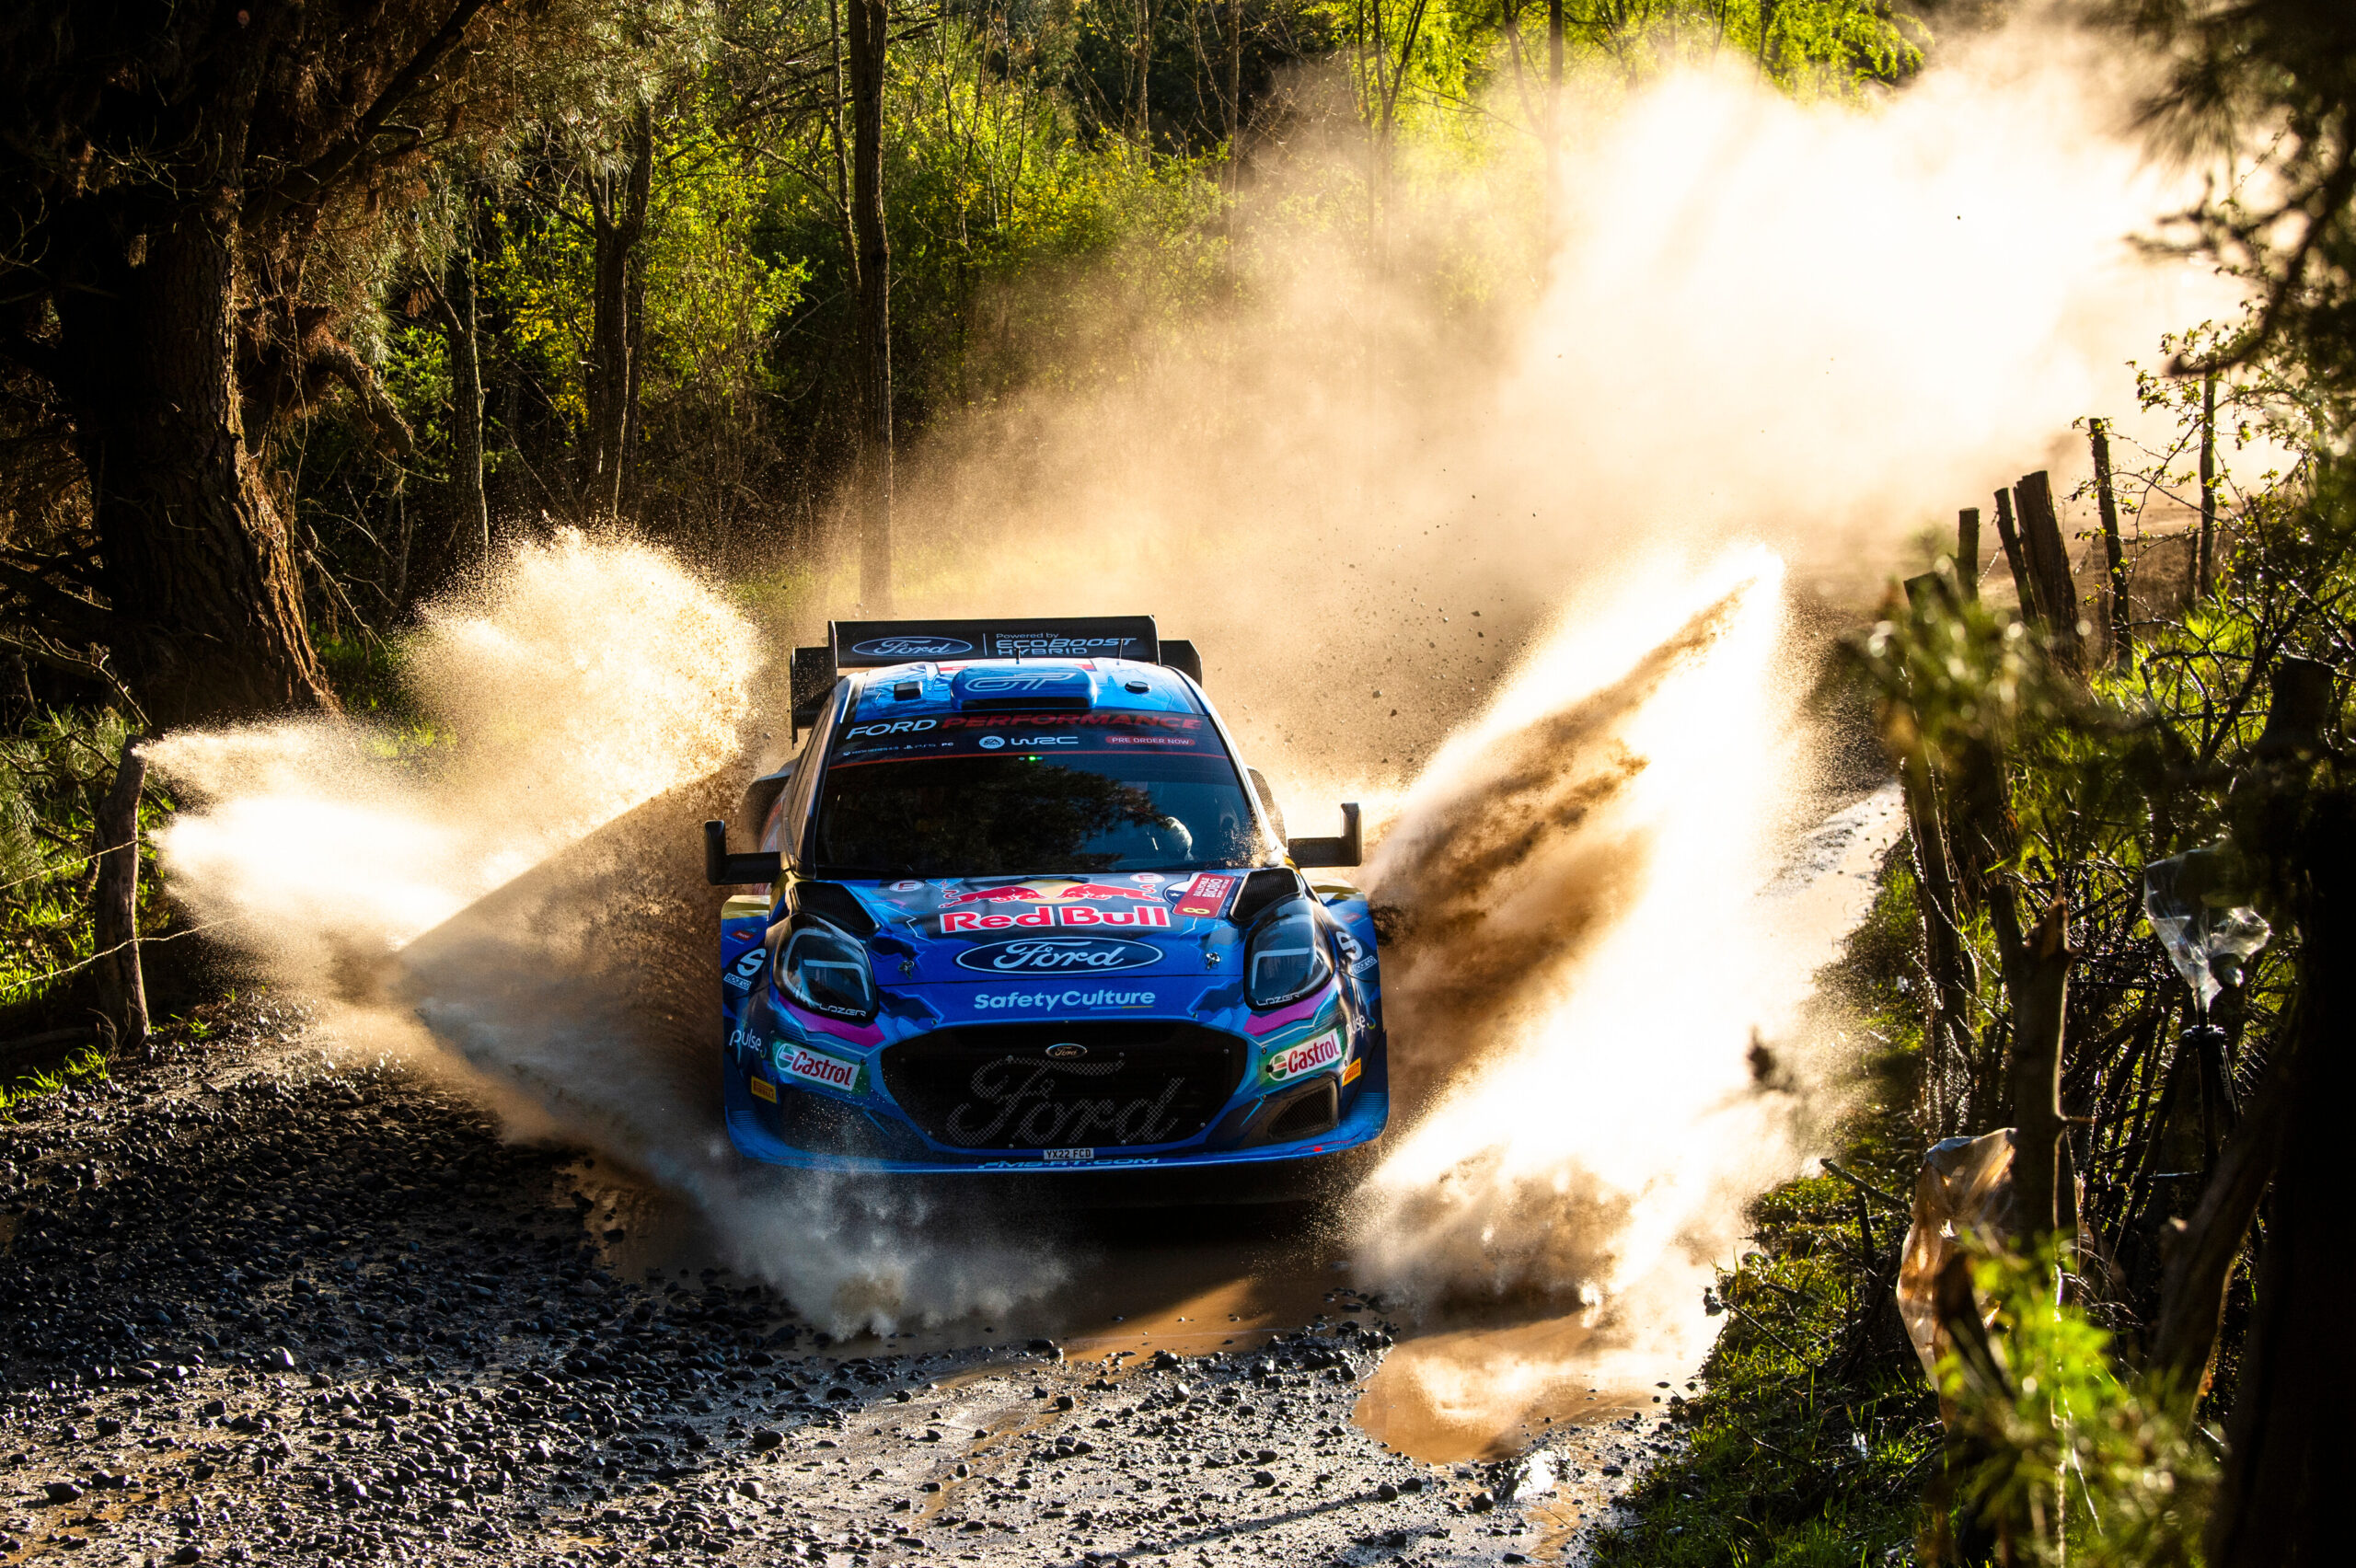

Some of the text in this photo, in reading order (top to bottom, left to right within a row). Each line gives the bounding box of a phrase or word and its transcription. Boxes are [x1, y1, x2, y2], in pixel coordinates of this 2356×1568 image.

[873, 640, 952, 654] Ford
[998, 647, 1088, 656] HYBRID
[846, 714, 1203, 740] FORD PERFORMANCE
[1011, 736, 1079, 745] WRC
[941, 905, 1172, 933] Red Bull
[1183, 906, 1211, 915] 8
[993, 940, 1126, 969] Ford
[819, 1002, 867, 1017] LAZER
[974, 989, 1156, 1011] SafetyCulture
[1256, 992, 1300, 1007] LAZER
[729, 1028, 763, 1054] pulse
[1288, 1034, 1340, 1074] Castrol
[791, 1051, 853, 1087] Castrol
[947, 1057, 1186, 1146] Ford
[1046, 1149, 1091, 1159] YX22 FCD
